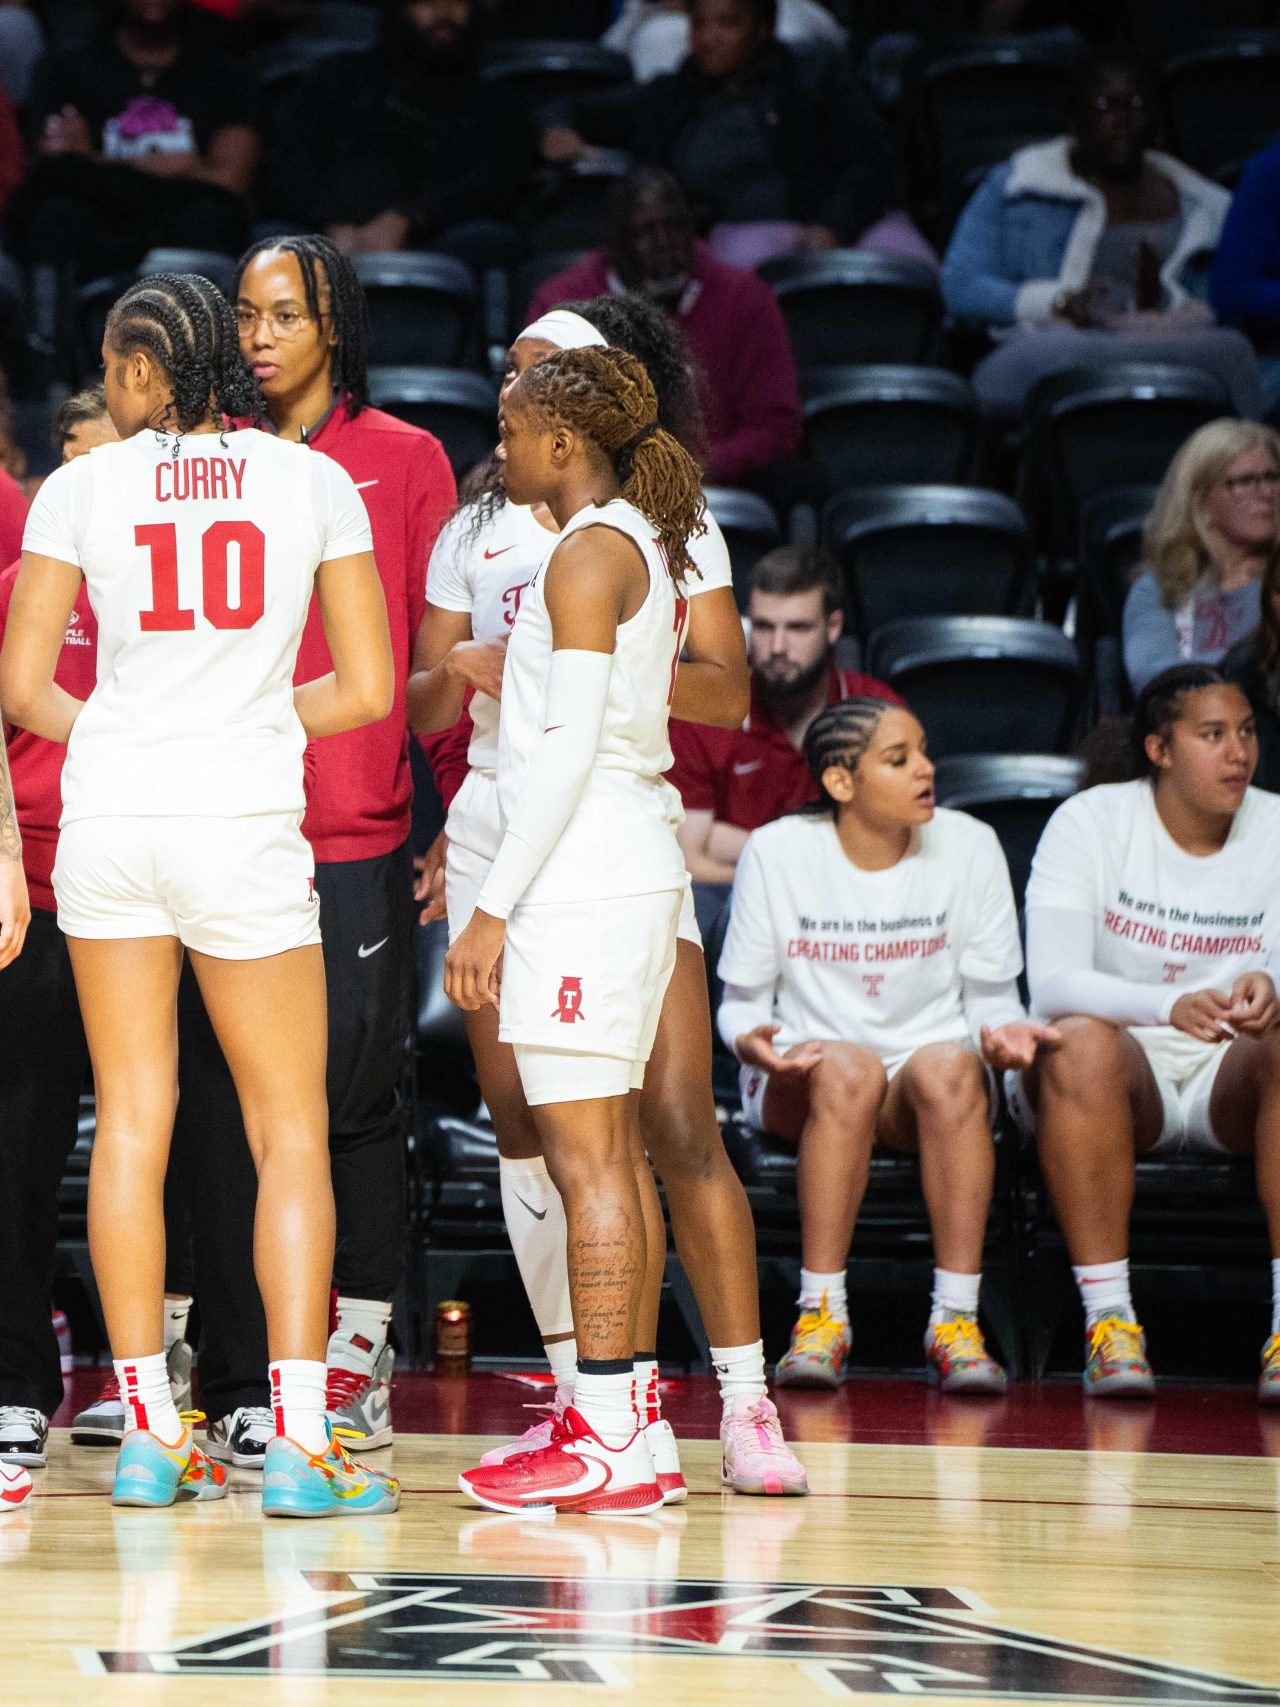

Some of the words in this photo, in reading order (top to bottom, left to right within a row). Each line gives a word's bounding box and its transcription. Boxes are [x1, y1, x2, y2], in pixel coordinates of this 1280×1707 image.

[156, 457, 247, 502] CURRY
[134, 521, 265, 631] 10
[64, 637, 91, 646] TBALL
[66, 629, 84, 637] PLE
[799, 915, 817, 930] We
[821, 920, 839, 931] are
[843, 918, 853, 932] in
[858, 918, 877, 932] the
[881, 915, 932, 932] business
[936, 911, 947, 926] of
[1136, 899, 1155, 915] are
[1170, 908, 1189, 923] the
[1193, 911, 1248, 927] business
[1251, 910, 1265, 926] of
[1104, 907, 1167, 949] REATING
[862, 974, 885, 997] T
[563, 990, 577, 1009] T
